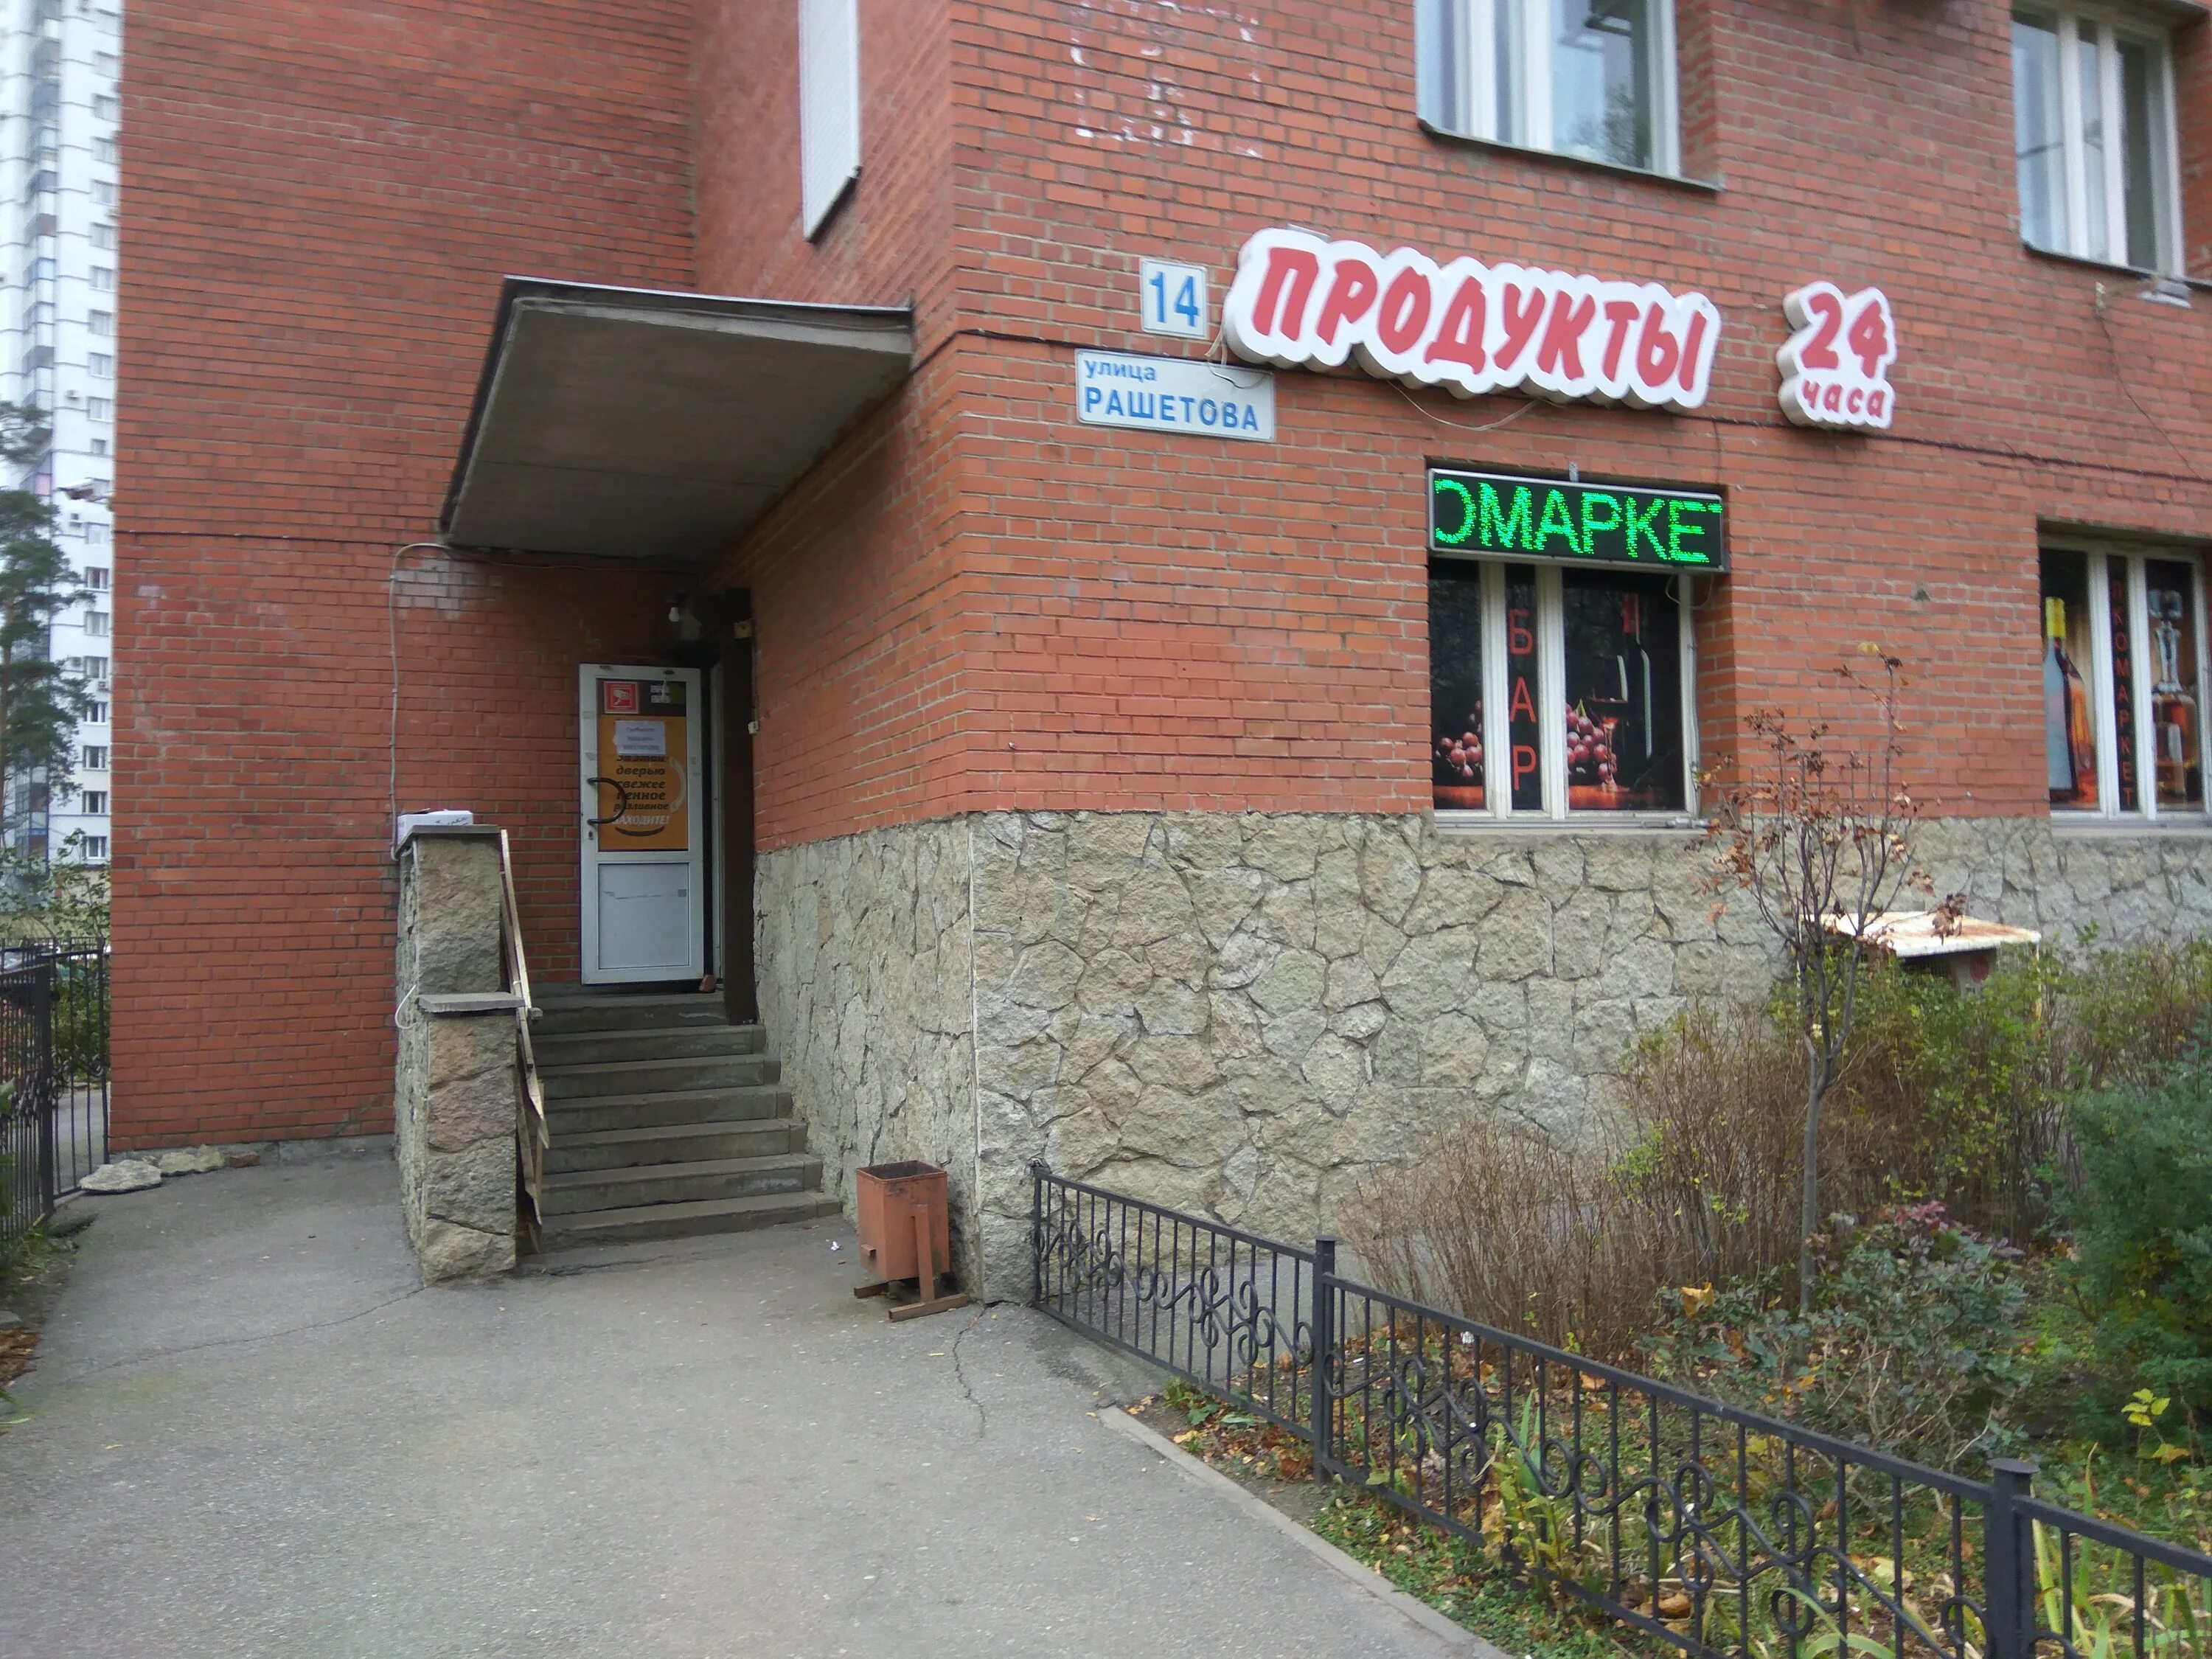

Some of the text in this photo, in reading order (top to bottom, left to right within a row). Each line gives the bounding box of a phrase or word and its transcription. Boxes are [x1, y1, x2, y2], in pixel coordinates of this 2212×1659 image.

[1149, 271, 1200, 327] 14
[1251, 246, 1708, 393] ПРОДУКТЫ
[1800, 292, 1888, 379] 24
[1084, 358, 1157, 382] улица
[1084, 386, 1259, 431] РАШЕТОВА
[1802, 379, 1886, 419] часа
[1434, 479, 1722, 563] ОМАРКЕ
[1509, 608, 1537, 791] БАР
[2112, 559, 2132, 807] ЛКОМАРКЕТ
[616, 765, 665, 776] дверью
[613, 803, 669, 812] рзливное
